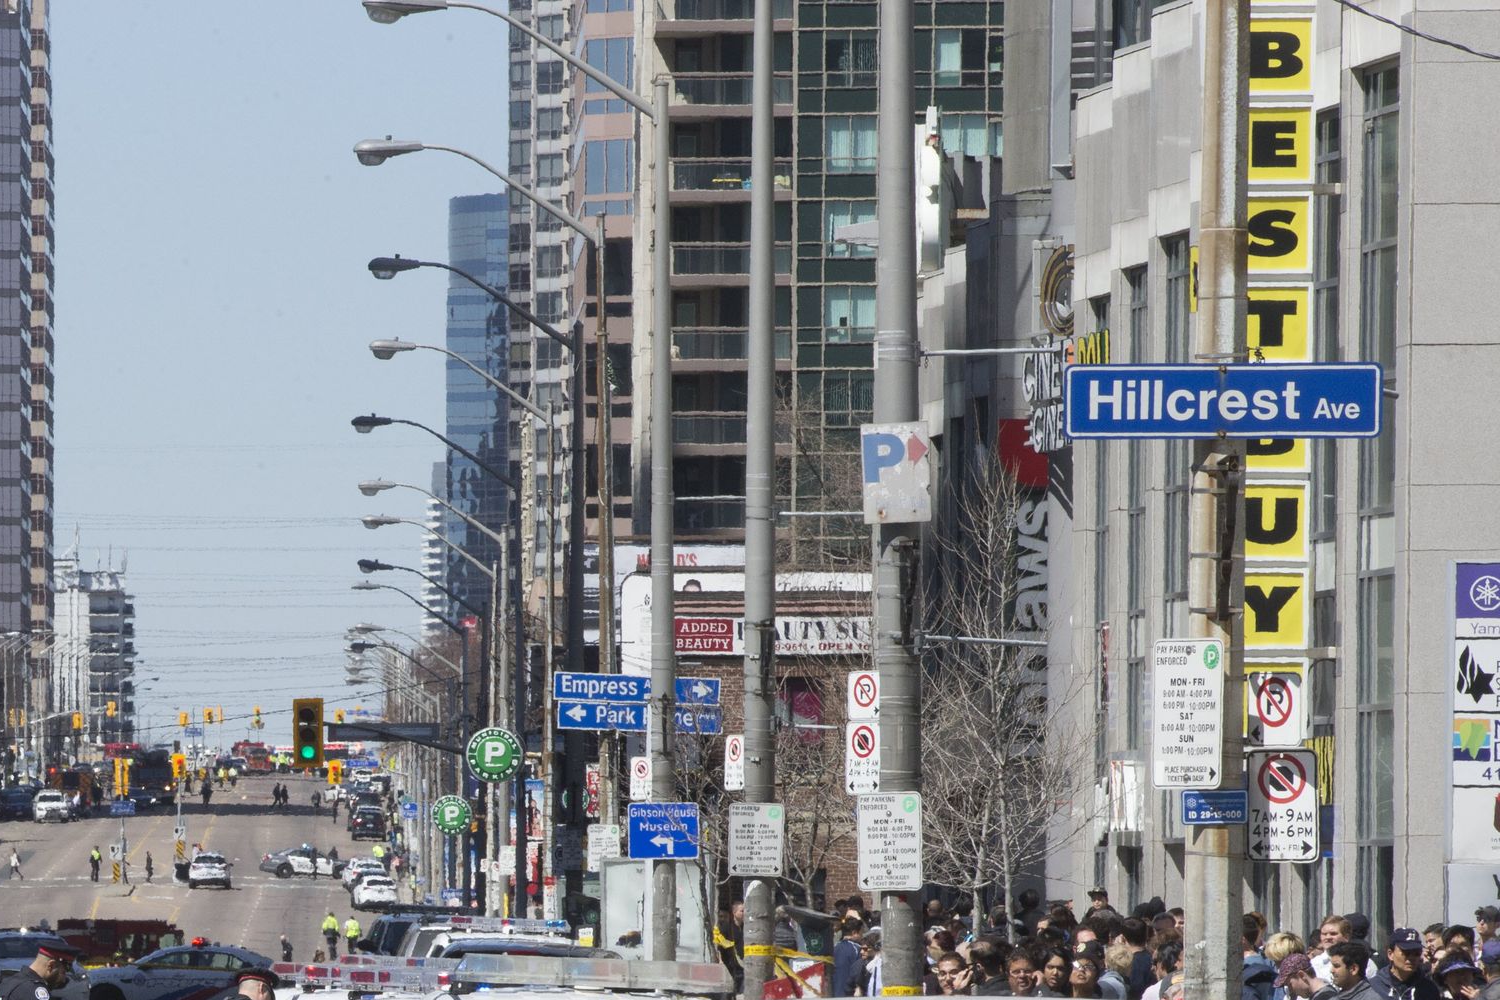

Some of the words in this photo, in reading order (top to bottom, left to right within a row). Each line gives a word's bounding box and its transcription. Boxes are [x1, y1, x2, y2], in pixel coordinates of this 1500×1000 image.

[1248, 31, 1304, 347] BEST
[1089, 379, 1300, 420] Hillcrest
[1313, 398, 1361, 420] Ave
[680, 622, 728, 633] ADDED
[676, 638, 731, 650] BEAUTY
[1156, 646, 1168, 655] PAY
[1156, 657, 1188, 666] ENFORCED
[561, 674, 639, 698] Empress
[1170, 678, 1188, 687] MON
[1192, 678, 1206, 687] FRI
[1176, 690, 1186, 698] AM
[1203, 690, 1213, 698] PM
[595, 705, 637, 725] Park
[1179, 712, 1194, 721] SAT
[1175, 724, 1185, 732] AM
[1179, 735, 1194, 743] SUN
[485, 741, 506, 763] P
[1174, 746, 1184, 754] PM
[630, 807, 664, 818] Gibson
[1188, 811, 1198, 819] ID
[639, 822, 688, 832] Museum
